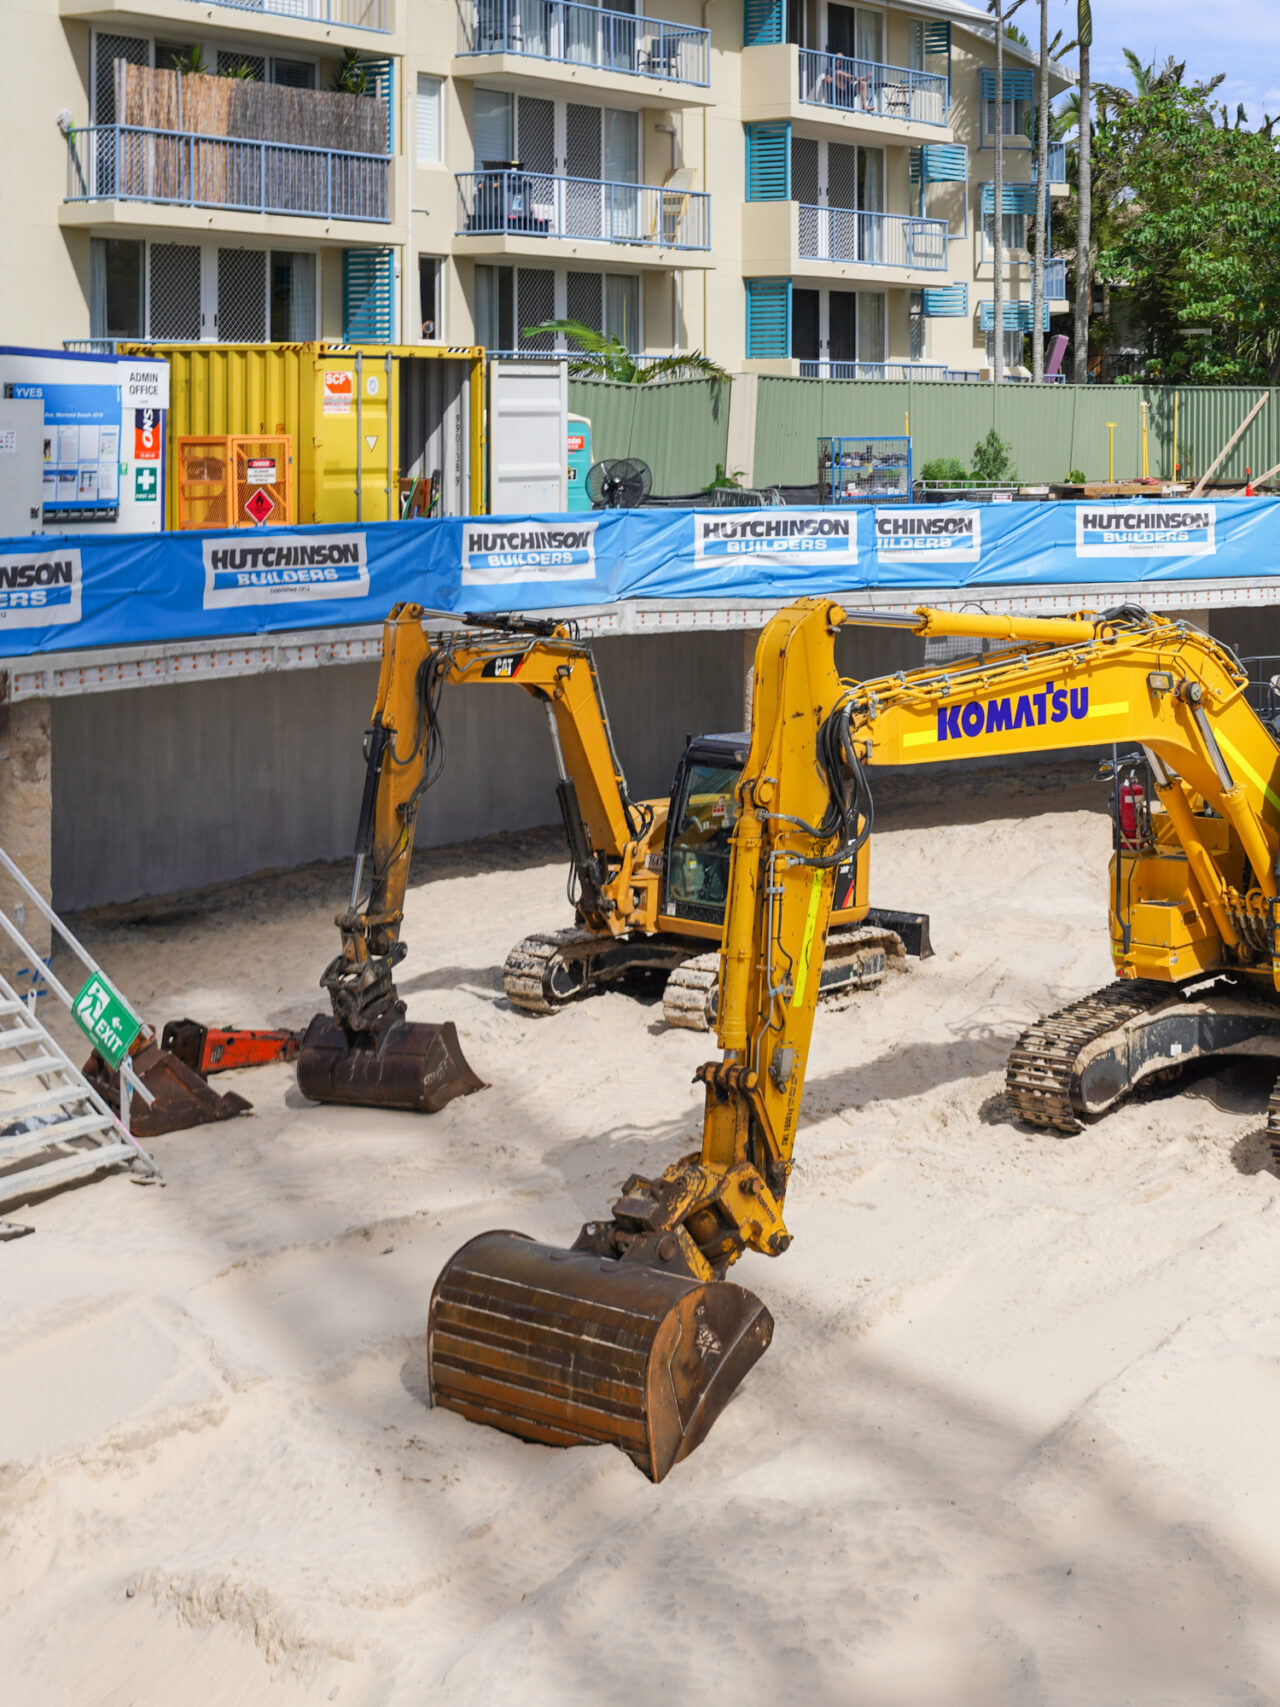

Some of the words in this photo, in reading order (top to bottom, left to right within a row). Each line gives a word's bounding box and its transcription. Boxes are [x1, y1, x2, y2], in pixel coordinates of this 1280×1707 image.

[130, 373, 158, 382] ADMIN
[326, 374, 346, 385] SCF
[16, 387, 43, 398] YVES
[130, 385, 159, 396] OFFICE
[142, 408, 153, 448] ONS
[703, 518, 850, 538] HUTCHINSON
[876, 517, 973, 535] CHINSON
[1082, 512, 1209, 530] HUTCHINSON
[468, 530, 589, 553] HUTCHINSON
[726, 538, 828, 553] BUILDERS
[877, 537, 952, 549] UILDERS
[1103, 530, 1189, 543] BUILDERS
[211, 543, 359, 570] HUTCHINSON
[488, 552, 573, 567] BUILDERS
[0, 560, 73, 589] NSON
[237, 568, 339, 587] BUILDERS
[0, 590, 47, 607] ERS
[495, 658, 513, 677] CAT
[937, 681, 1089, 742] KOMATSU
[94, 1018, 123, 1053] EXIT
